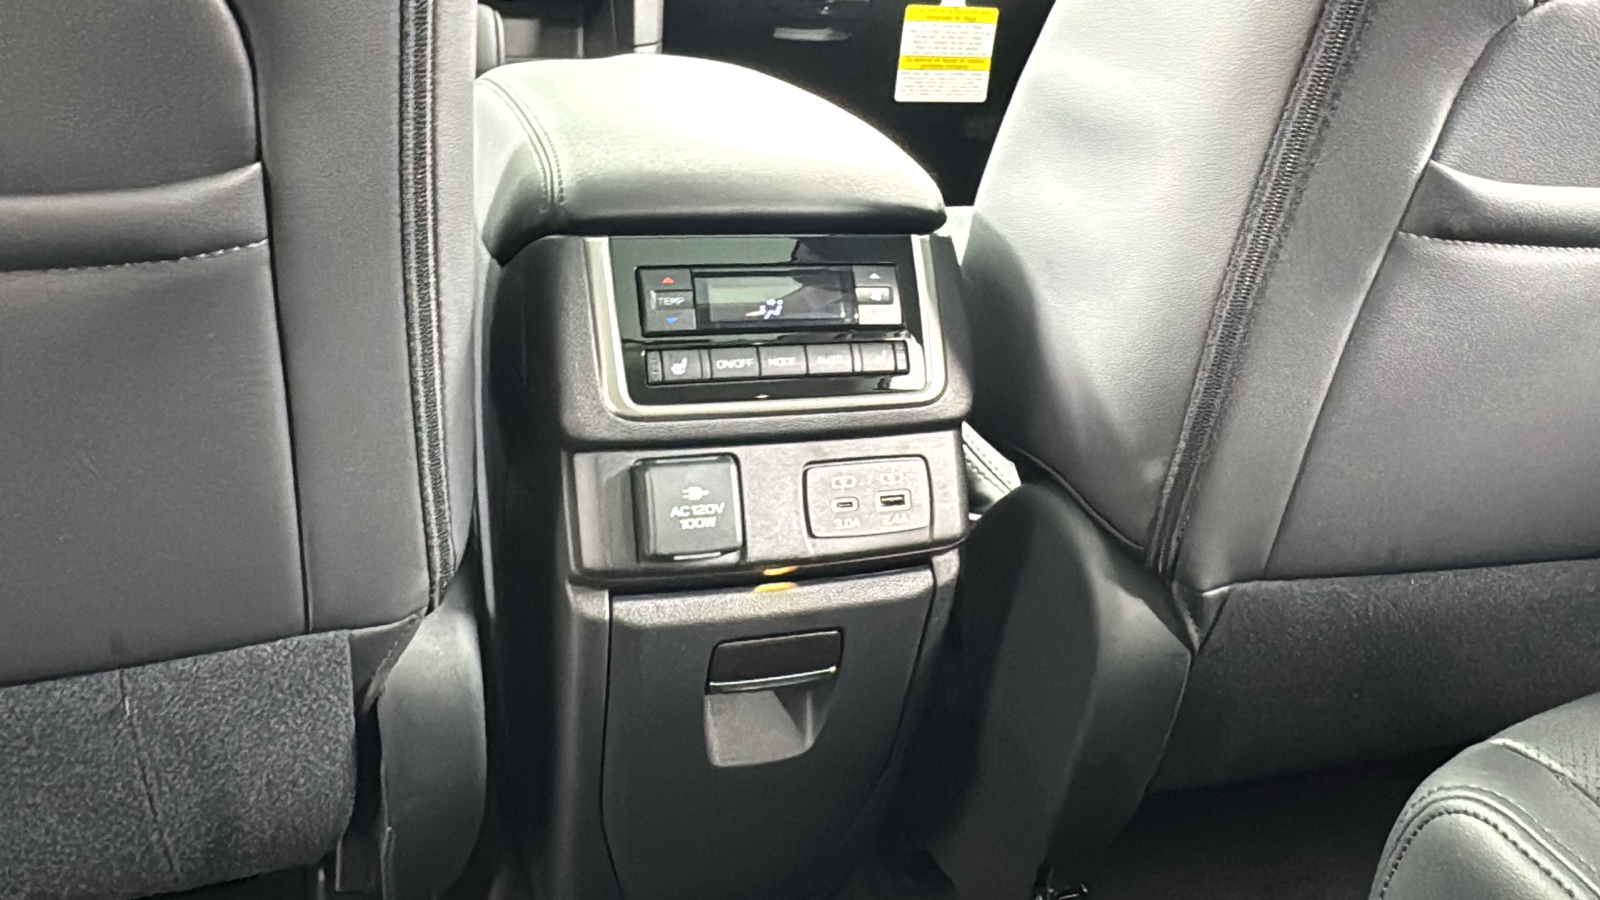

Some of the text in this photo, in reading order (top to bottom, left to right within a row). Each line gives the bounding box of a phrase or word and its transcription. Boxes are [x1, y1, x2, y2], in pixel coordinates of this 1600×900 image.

[658, 297, 685, 306] TEMP
[716, 358, 754, 369] ON/OFF
[767, 357, 797, 366] MODE
[680, 517, 716, 529] 100W
[834, 517, 861, 530] 3.0A
